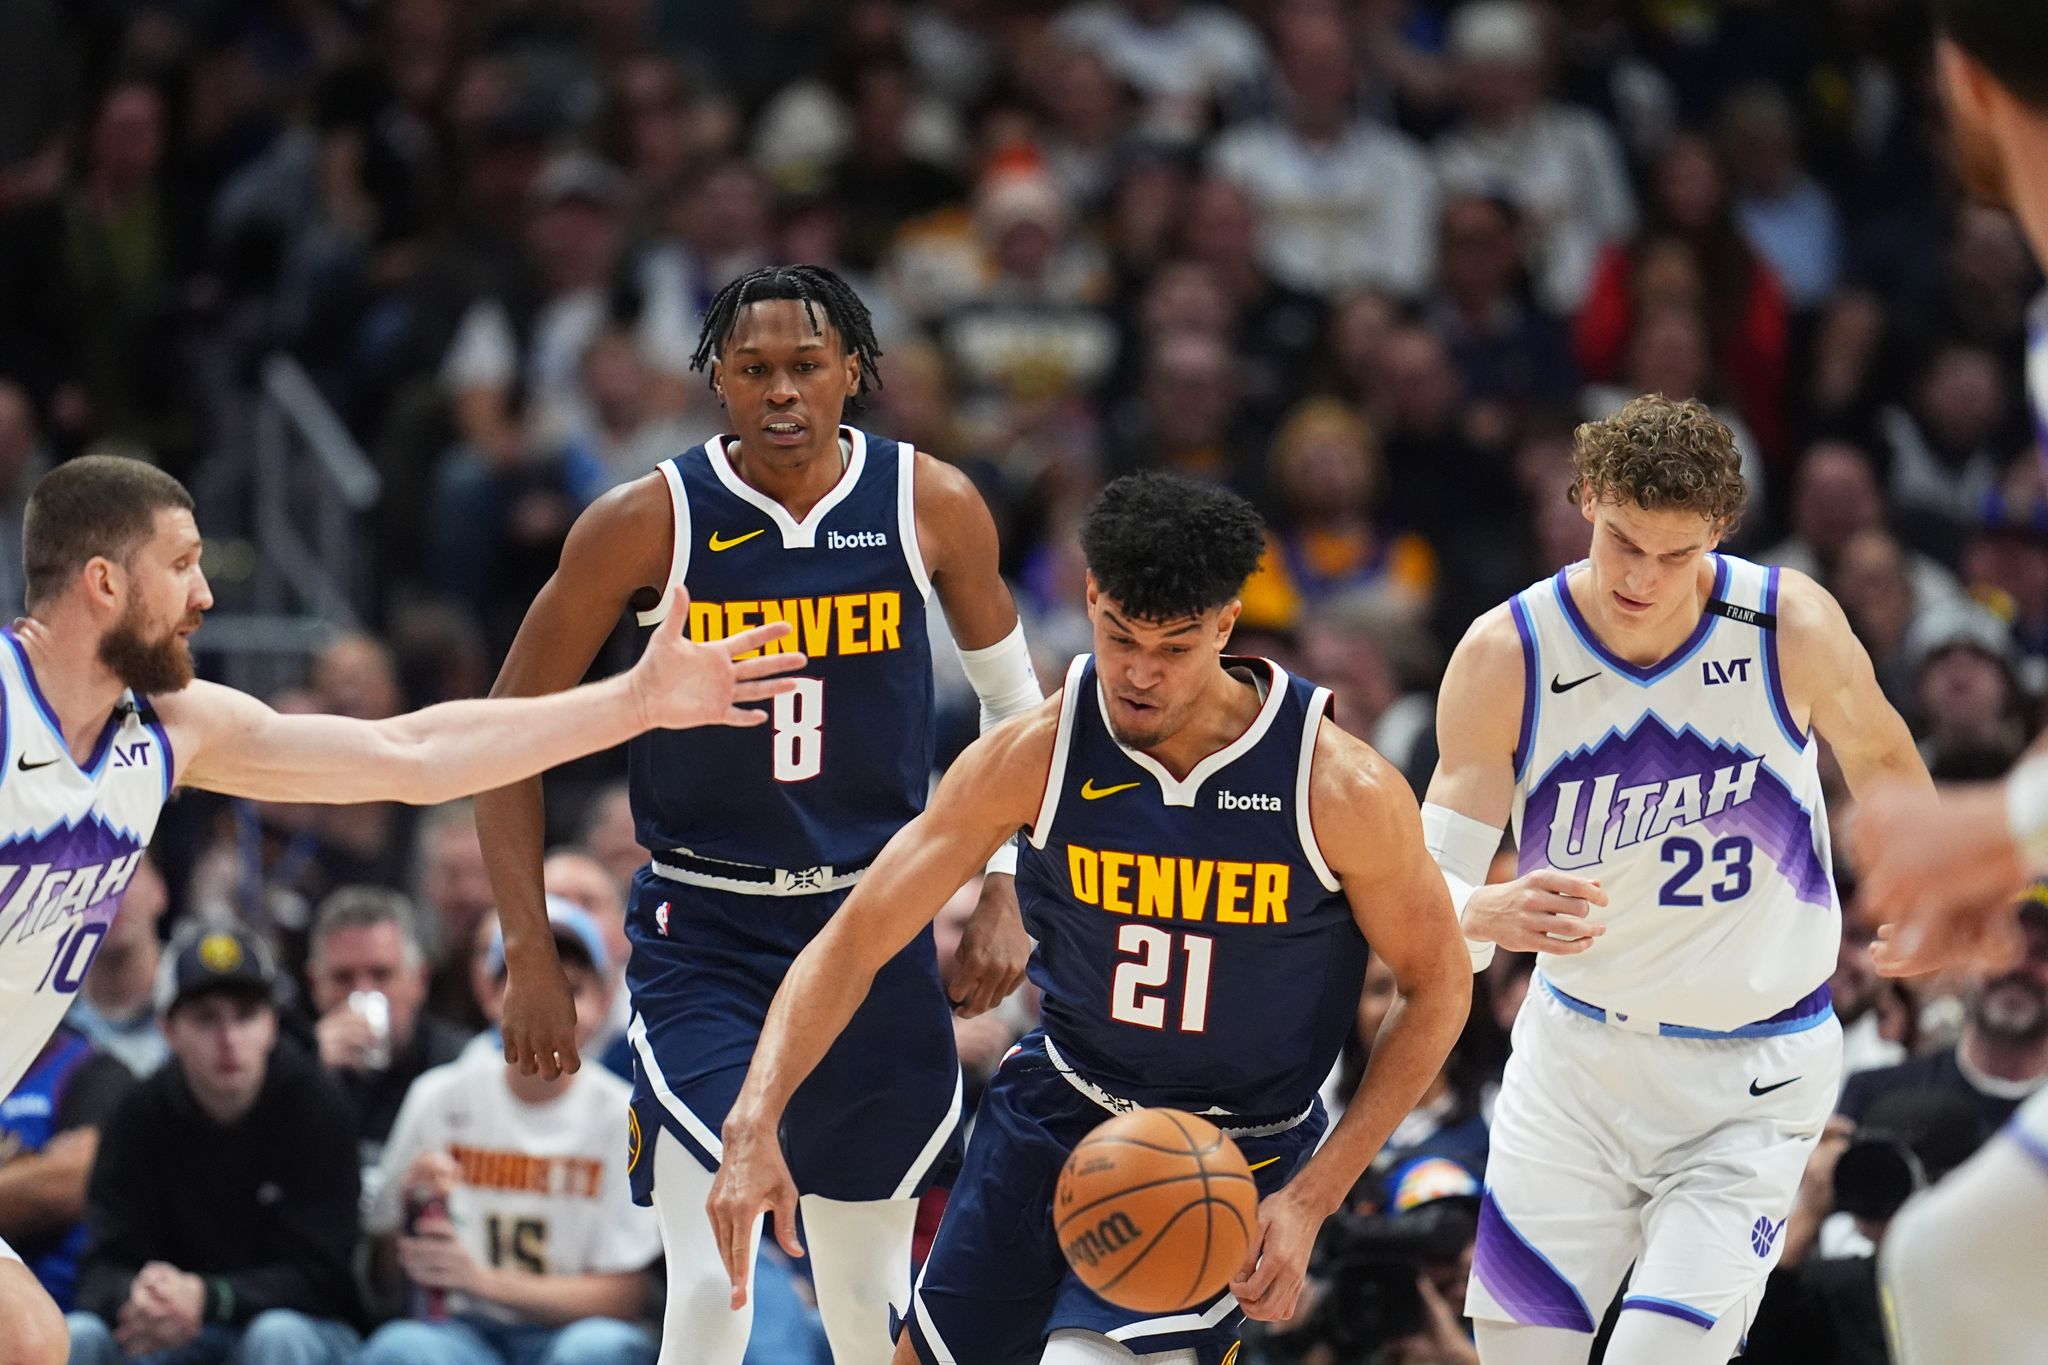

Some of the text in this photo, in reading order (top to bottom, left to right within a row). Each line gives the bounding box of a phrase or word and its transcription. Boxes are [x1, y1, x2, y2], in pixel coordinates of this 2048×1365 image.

[828, 531, 887, 549] ibotta
[689, 590, 901, 662] DENVER
[1726, 605, 1756, 623] FRANK
[1702, 657, 1752, 686] LVT
[772, 675, 825, 784] 8
[1218, 791, 1282, 811] ibotta
[1546, 754, 1766, 870] UTAH
[1067, 844, 1290, 924] DENVER
[1659, 836, 1753, 906] 23
[1111, 923, 1213, 1033] 21
